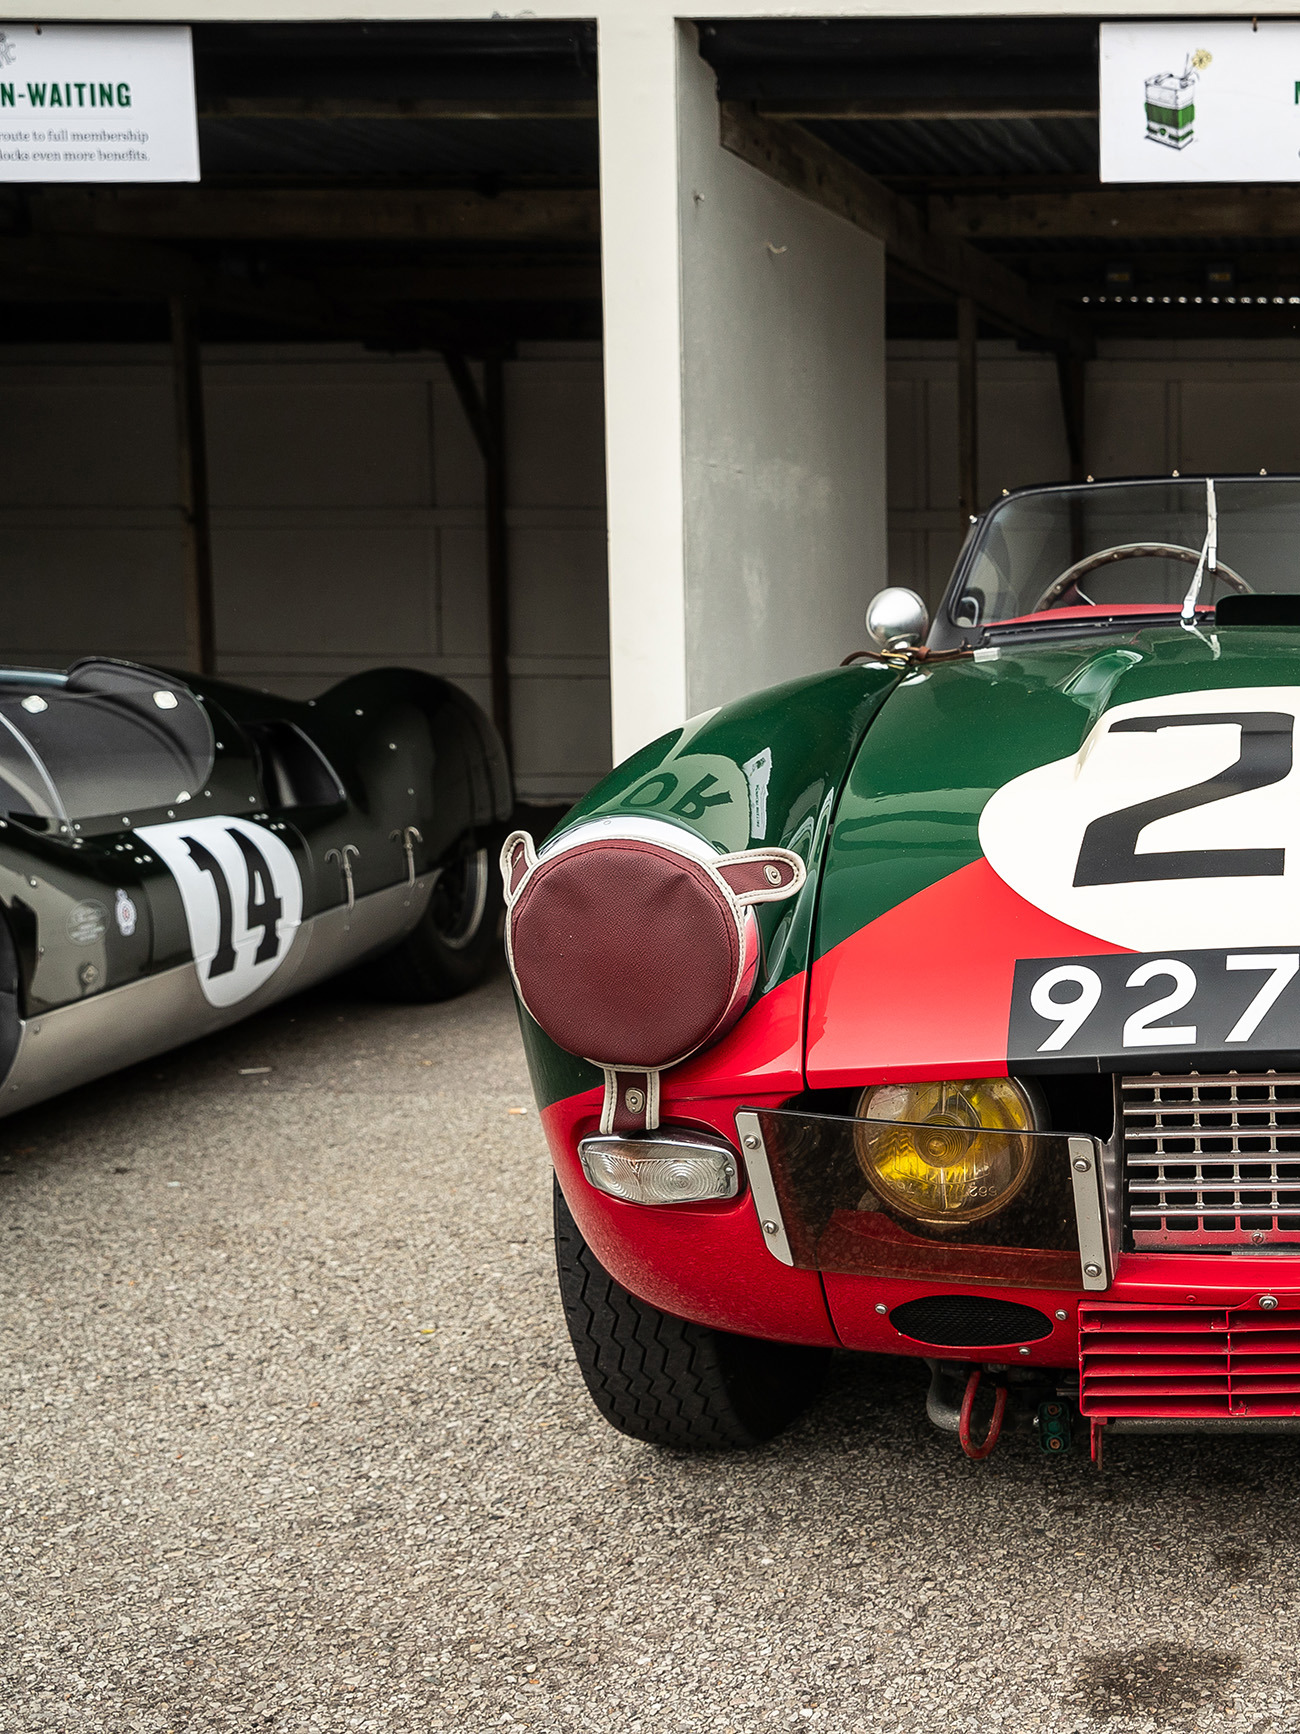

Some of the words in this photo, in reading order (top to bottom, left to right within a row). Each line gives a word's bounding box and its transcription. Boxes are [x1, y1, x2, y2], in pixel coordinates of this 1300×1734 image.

[33, 131, 46, 142] to
[48, 129, 69, 142] full
[70, 129, 150, 144] membership
[33, 152, 61, 161] even
[63, 152, 96, 161] more
[98, 148, 151, 161] benefits.
[179, 828, 282, 980] 14
[1030, 953, 1300, 1052] 927
